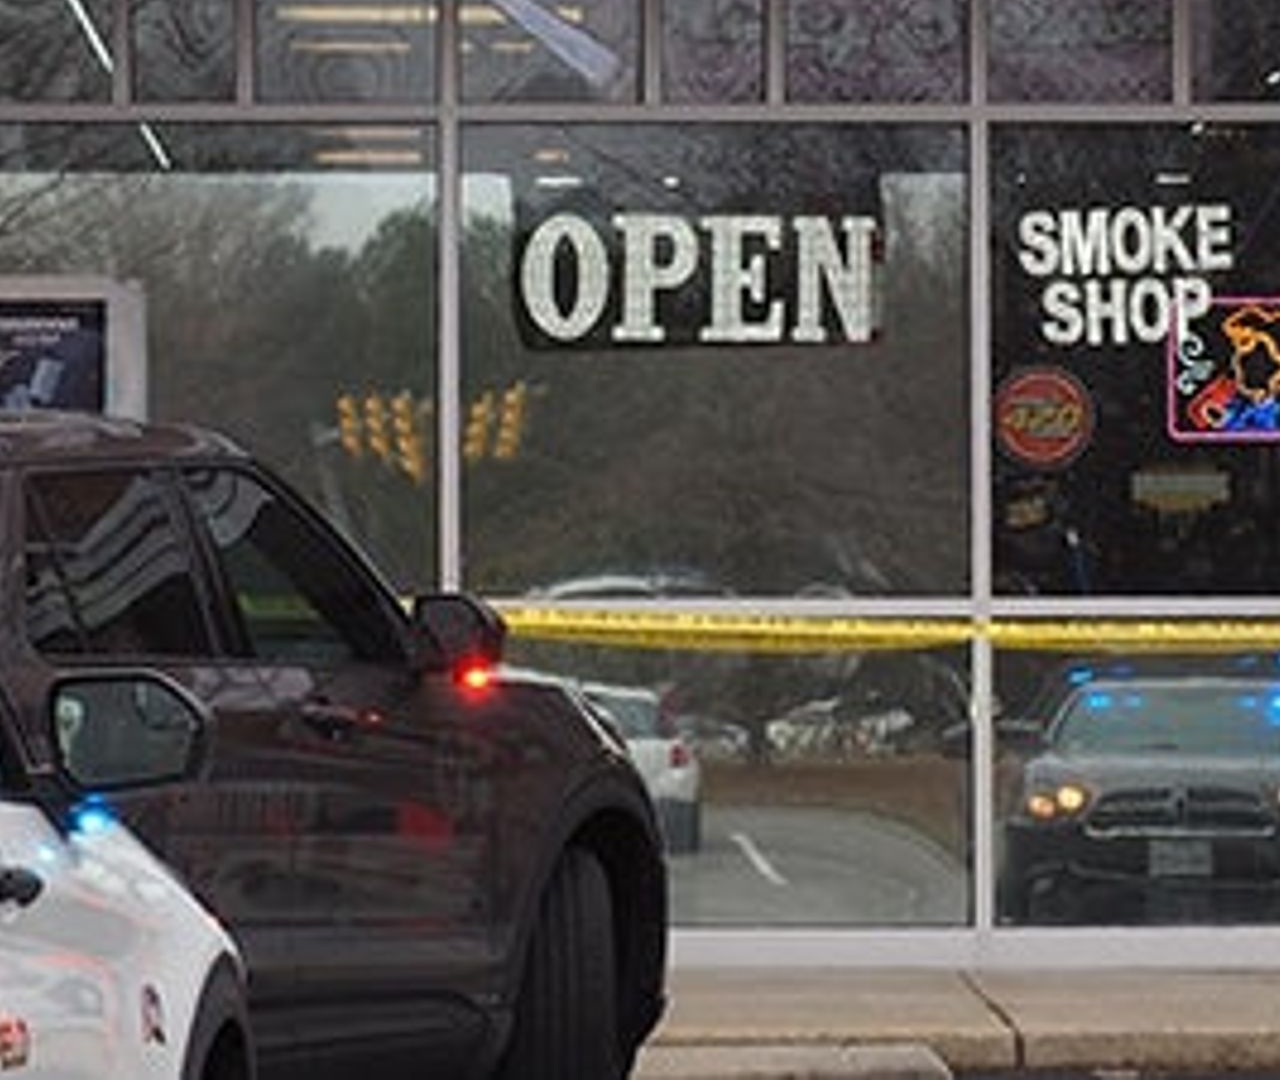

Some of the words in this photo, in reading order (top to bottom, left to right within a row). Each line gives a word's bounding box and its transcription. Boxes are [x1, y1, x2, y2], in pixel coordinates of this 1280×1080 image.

[1018, 204, 1235, 277] SMOKE
[522, 212, 877, 344] OPEN
[1041, 276, 1212, 347] SHOP
